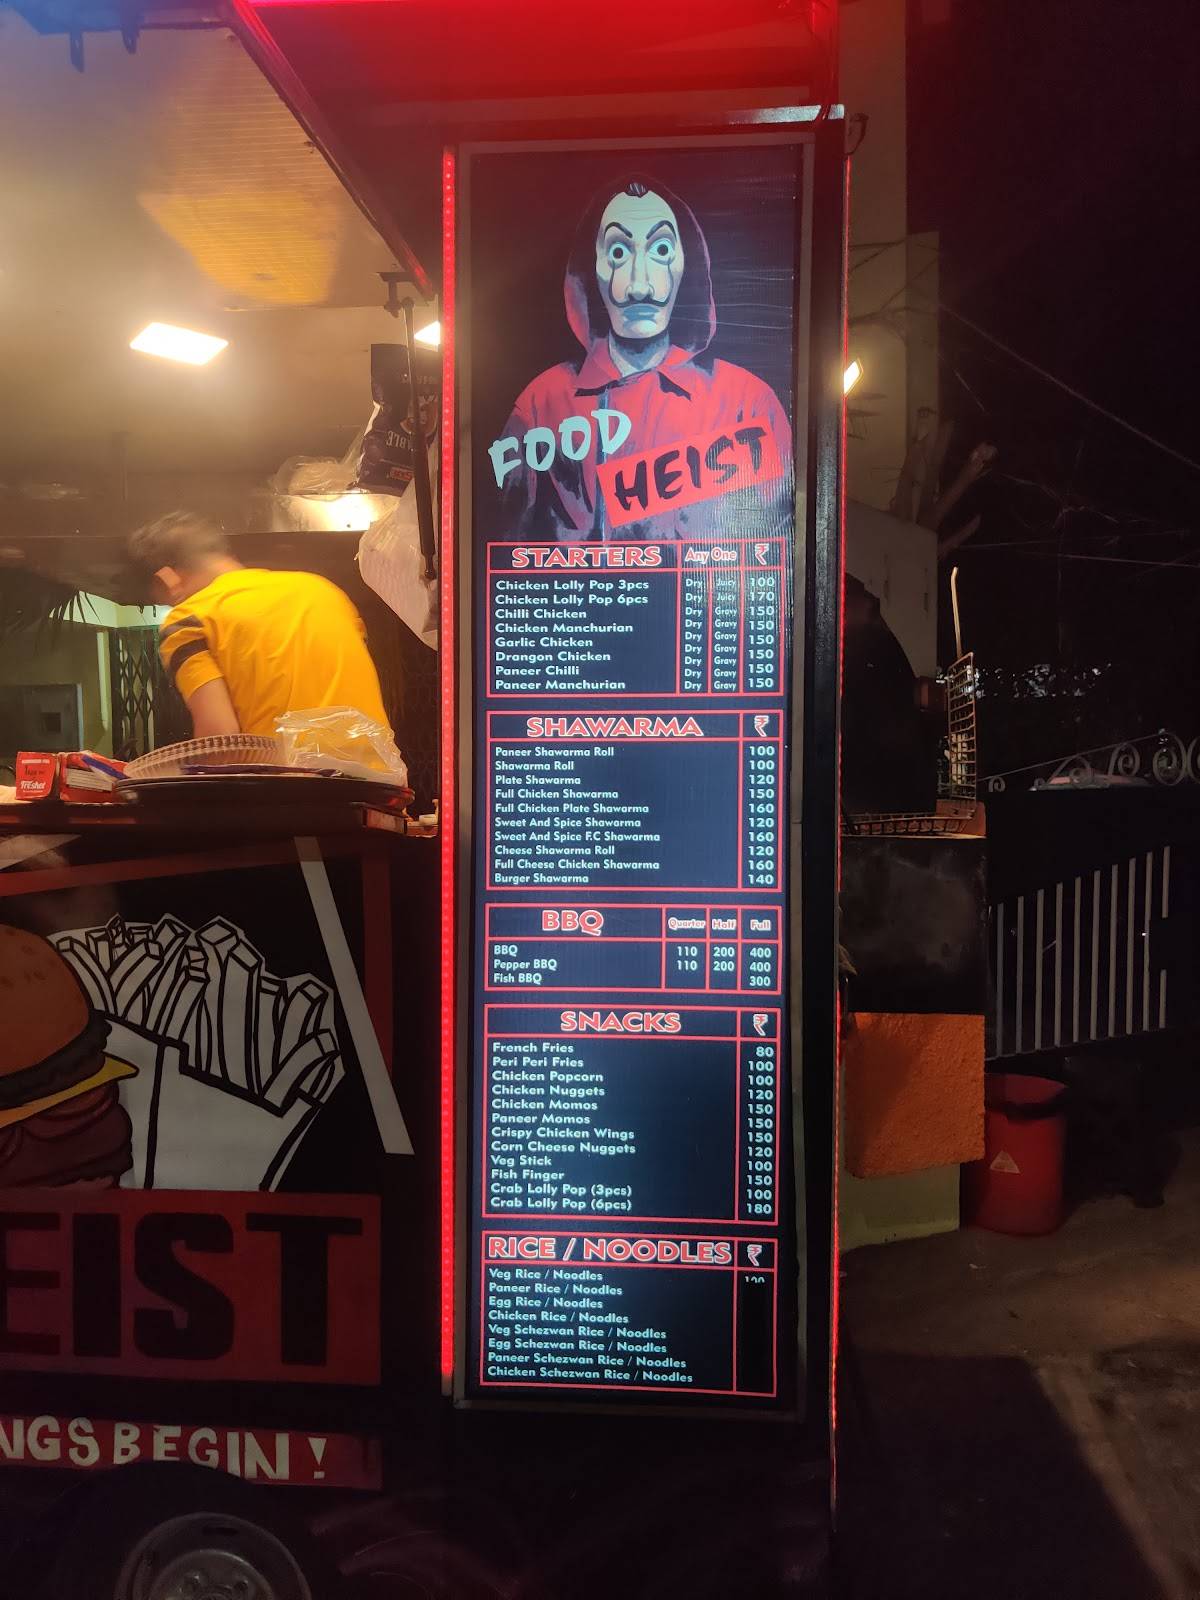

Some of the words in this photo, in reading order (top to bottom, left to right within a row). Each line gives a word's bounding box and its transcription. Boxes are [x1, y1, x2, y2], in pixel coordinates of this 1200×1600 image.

[488, 408, 632, 490] FOOD
[614, 426, 767, 511] HEIST
[512, 546, 662, 568] STARTERS
[685, 547, 709, 564] Any
[711, 547, 737, 561] One
[496, 580, 549, 590] Chicken
[554, 580, 584, 591] Lolly
[589, 580, 613, 591] Pop
[618, 579, 649, 591] 3pcs
[750, 578, 774, 587] 100
[494, 608, 529, 618] Chilli
[533, 608, 586, 618] Chicken
[685, 607, 702, 617] Dry
[750, 606, 774, 616] 150
[494, 623, 548, 632] Chicken
[552, 622, 633, 632] Manchurian
[714, 619, 737, 629] Gravy
[749, 620, 774, 630] 150
[495, 636, 535, 647] Garlic
[540, 636, 593, 646] Chicken
[685, 632, 702, 642] Dry
[749, 634, 774, 644] 150
[714, 644, 737, 654] Gravy
[748, 648, 774, 659] 150
[496, 651, 552, 663] Drangon
[557, 650, 610, 661] Chicken
[685, 656, 702, 666] Dry
[496, 666, 541, 675] Paneer
[545, 665, 579, 675] Chilli
[714, 668, 737, 678] Gravy
[748, 663, 773, 673] 150
[496, 679, 541, 689] Paneer
[545, 679, 625, 689] Manchurian
[685, 681, 702, 691] Dry
[748, 677, 773, 687] 150
[526, 717, 704, 737] SHAWARMA
[495, 746, 531, 756] Paneer
[534, 746, 590, 756] Shawarma
[594, 746, 614, 756] Roll
[749, 746, 774, 756] 100
[495, 760, 550, 770] Shawarma
[554, 760, 574, 770] Roll
[749, 759, 774, 770] 100
[495, 775, 522, 784] Plate
[525, 774, 580, 784] Shawarma
[749, 774, 774, 784] 120
[495, 803, 514, 812] Full
[517, 802, 559, 812] Chicken
[563, 803, 589, 812] Plate
[593, 802, 649, 812] Shawarma
[748, 803, 774, 813] 160
[494, 831, 526, 840] Sweet
[528, 831, 550, 840] And
[553, 830, 582, 842] Spice
[585, 831, 600, 840] F.C
[604, 830, 660, 841] Shawarma
[748, 831, 774, 842] 160
[494, 844, 532, 854] Cheese
[535, 844, 591, 854] Shawarma
[594, 845, 614, 854] Roll
[748, 846, 774, 856] 120
[494, 858, 513, 868] Full
[516, 858, 554, 868] Cheese
[557, 858, 600, 868] Chicken
[603, 858, 659, 869] Shawarma
[748, 859, 774, 870] 160
[494, 872, 530, 884] Burger
[533, 872, 588, 882] Shawarma
[748, 874, 774, 884] 140
[541, 910, 604, 936] BBQ
[668, 917, 706, 930] Quarter
[712, 919, 737, 930] Half
[750, 920, 771, 931] Full
[494, 944, 518, 957] BBQ
[677, 946, 697, 956] 110
[713, 946, 734, 957] 200
[749, 947, 771, 958] 400
[494, 958, 530, 970] Pepper
[533, 958, 557, 970] BBQ
[677, 960, 697, 970] 110
[713, 960, 734, 971] 200
[749, 961, 770, 972] 400
[493, 972, 514, 982] Fish
[518, 972, 542, 985] BBQ
[749, 975, 770, 986] 300
[560, 1011, 681, 1032] SNACKS
[493, 1042, 537, 1052] French
[542, 1042, 574, 1052] Fries
[755, 1046, 774, 1057] 80
[492, 1056, 517, 1066] Peri
[522, 1056, 547, 1066] Peri
[552, 1056, 583, 1067] Fries
[748, 1060, 774, 1071] 100
[492, 1070, 544, 1081] Chicken
[549, 1070, 603, 1083] Popcorn
[748, 1074, 773, 1086] 100
[491, 1098, 544, 1108] Chicken
[549, 1099, 597, 1110] Momos
[747, 1103, 773, 1114] 150
[491, 1126, 532, 1139] Crispy
[536, 1126, 589, 1138] Chicken
[593, 1128, 634, 1141] Wings
[747, 1131, 772, 1143] 150
[490, 1155, 514, 1167] Veg
[519, 1154, 551, 1165] Stick
[747, 1160, 772, 1171] 100
[491, 1168, 517, 1178] Fish
[522, 1169, 564, 1181] Finger
[747, 1174, 772, 1185] 150
[490, 1182, 522, 1193] Crab
[527, 1183, 557, 1196] Lolly
[562, 1183, 586, 1196] Pop
[591, 1184, 631, 1197] (3pcs)
[747, 1189, 772, 1200] 100
[488, 1237, 556, 1258] RICE
[583, 1238, 732, 1264] NOODLES
[488, 1268, 510, 1280] Veg
[515, 1268, 541, 1278] Rice
[553, 1269, 602, 1280] Noodles
[489, 1282, 530, 1292] Paneer
[534, 1282, 560, 1293] Rice
[572, 1284, 622, 1295] Noodles
[488, 1309, 536, 1320] Chicken
[540, 1310, 567, 1321] Rice
[578, 1311, 628, 1323] Noodles
[488, 1337, 510, 1352] Egg
[514, 1338, 574, 1349] Schezwan
[578, 1339, 604, 1350] Rice
[616, 1341, 666, 1352] Noodles
[487, 1365, 535, 1376] Chicken
[540, 1366, 599, 1378] Schezwan
[604, 1368, 630, 1379] Rice
[642, 1370, 692, 1382] Noodles
[113, 1423, 290, 1480] BEGIN
[308, 1437, 328, 1479] !
